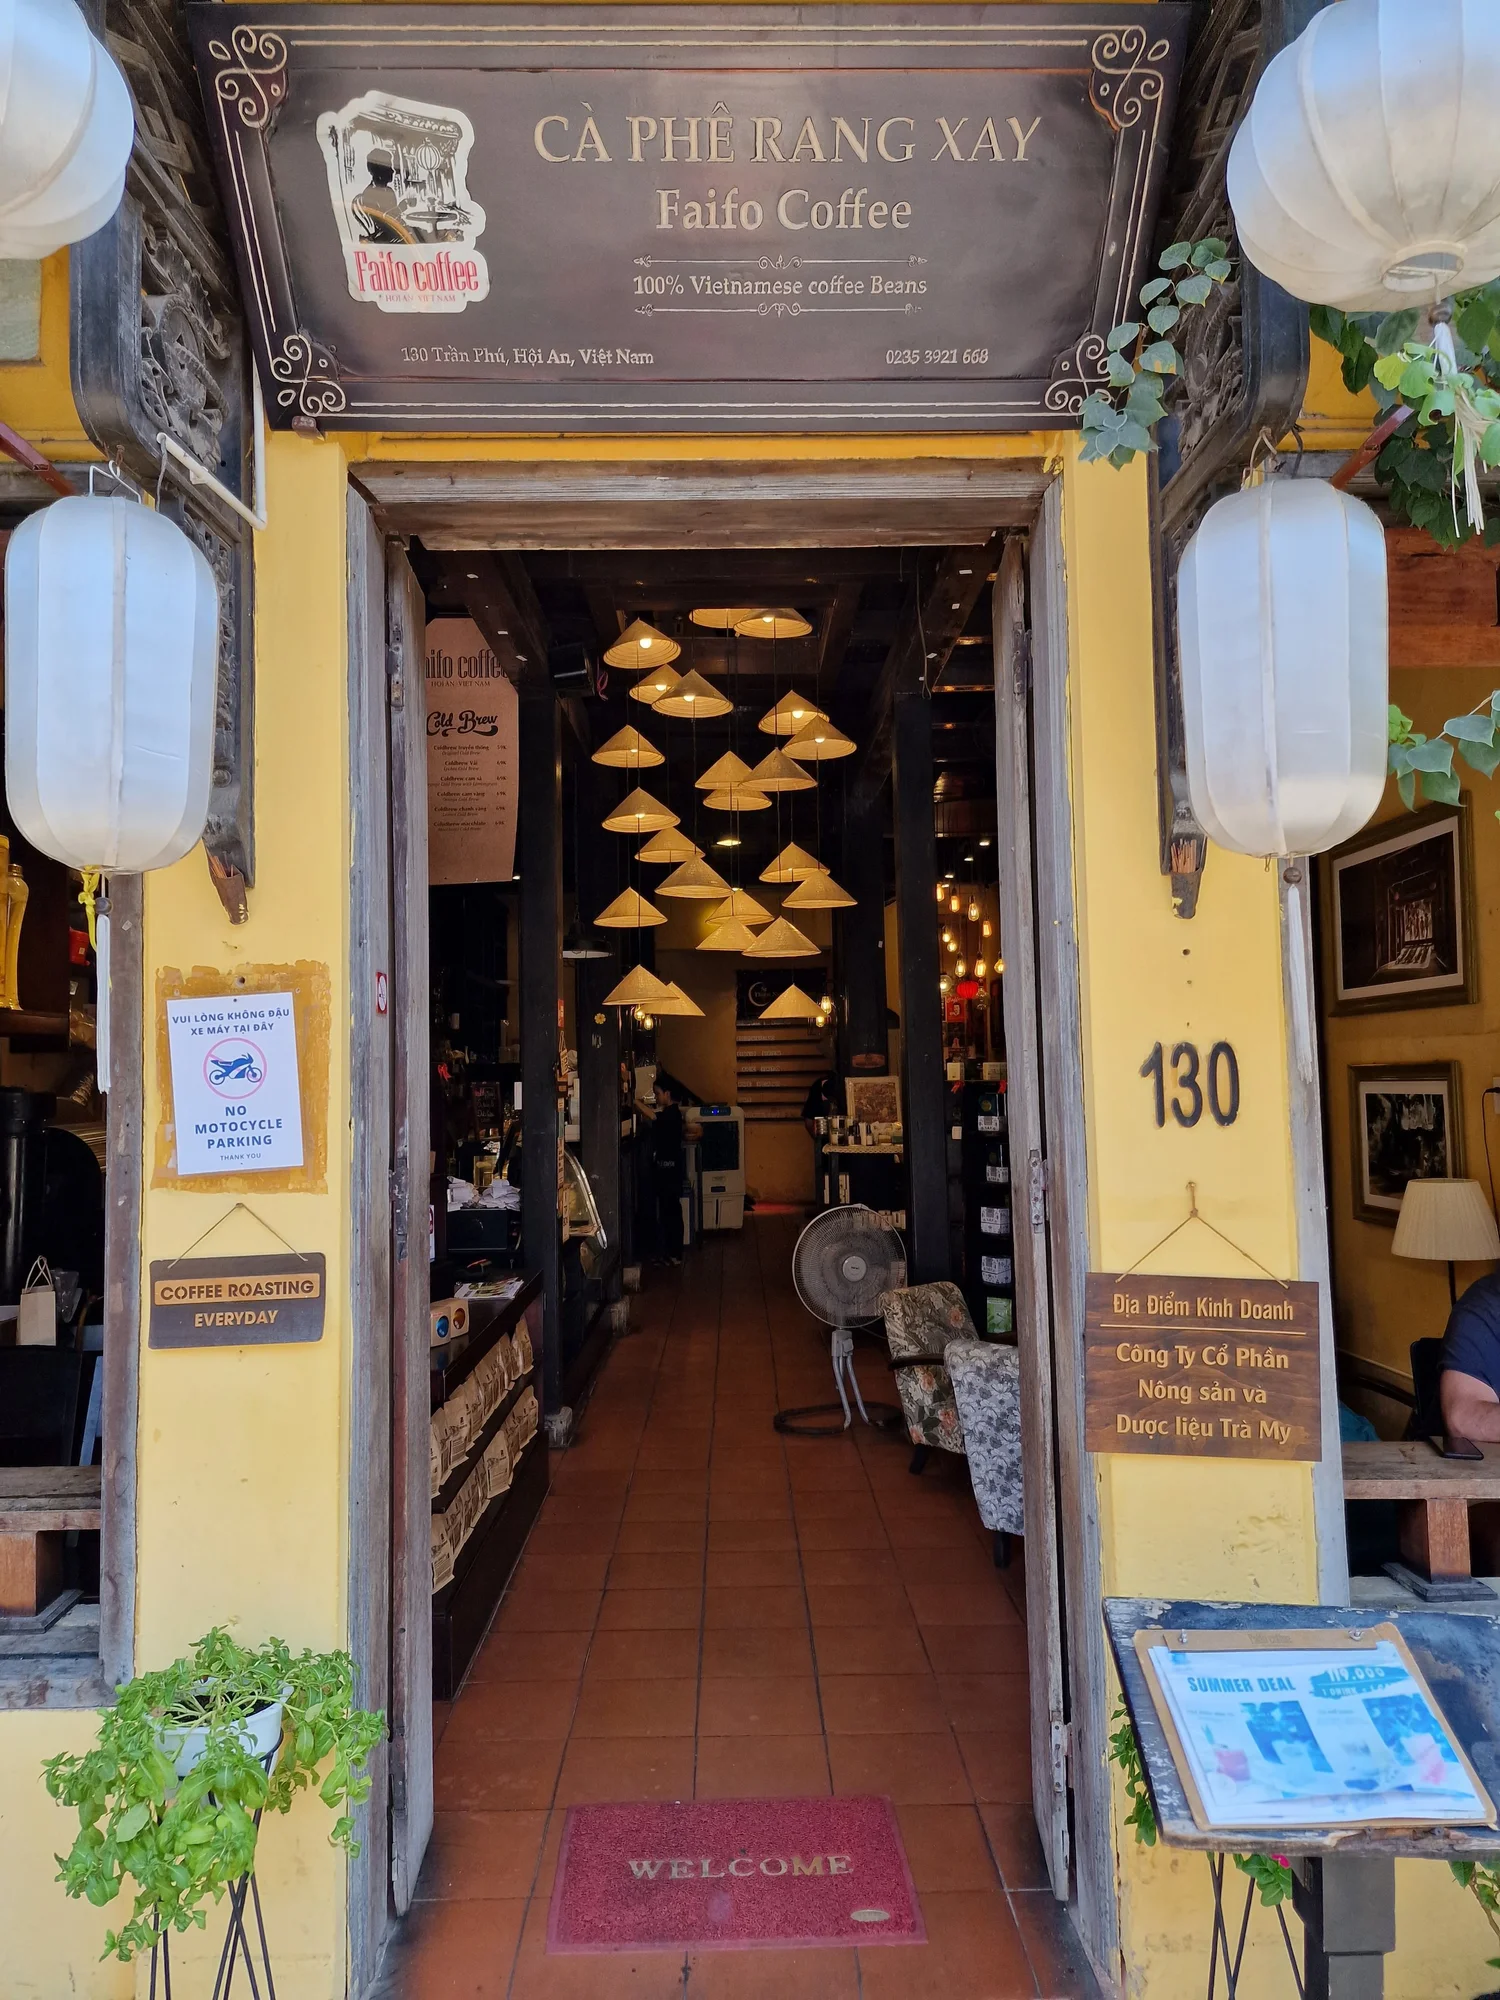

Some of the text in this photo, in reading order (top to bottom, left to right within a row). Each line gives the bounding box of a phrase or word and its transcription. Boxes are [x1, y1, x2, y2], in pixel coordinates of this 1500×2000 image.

[533, 100, 1042, 162] CÀ PHÊ RANG XAY
[655, 187, 912, 230] Faifo Coffee
[354, 250, 479, 292] Faifo coffee
[633, 275, 927, 294] 100% Vietnamese coffee Beans
[401, 345, 654, 367] 130 Trần Phú, Hội An, Việt Nam
[885, 348, 989, 365] 0235 3921 668
[426, 710, 499, 737] Cold Brew
[172, 1008, 290, 1024] VUI LÒNG KHÔNG ĐẬU
[190, 1020, 275, 1036] XE MÁY TẠI ĐÂY
[1139, 1041, 1240, 1128] 130
[225, 1105, 247, 1117] NO
[195, 1118, 283, 1135] MOTOCYCLE
[207, 1135, 273, 1149] PARKING
[220, 1152, 262, 1162] THANK YOU
[160, 1280, 314, 1300] COFFEE ROASTING
[1113, 1291, 1294, 1321] Địa Điểm Kinh Doanh
[194, 1310, 279, 1328] EVERYDAY
[1116, 1343, 1289, 1369] Công Ty Cổ Phần
[1138, 1379, 1267, 1405] Nông sản và
[1116, 1413, 1292, 1445] Dược liệu Trà My
[1187, 1676, 1297, 1692] SUMMER DEAL
[628, 1854, 853, 1880] WELCOME
